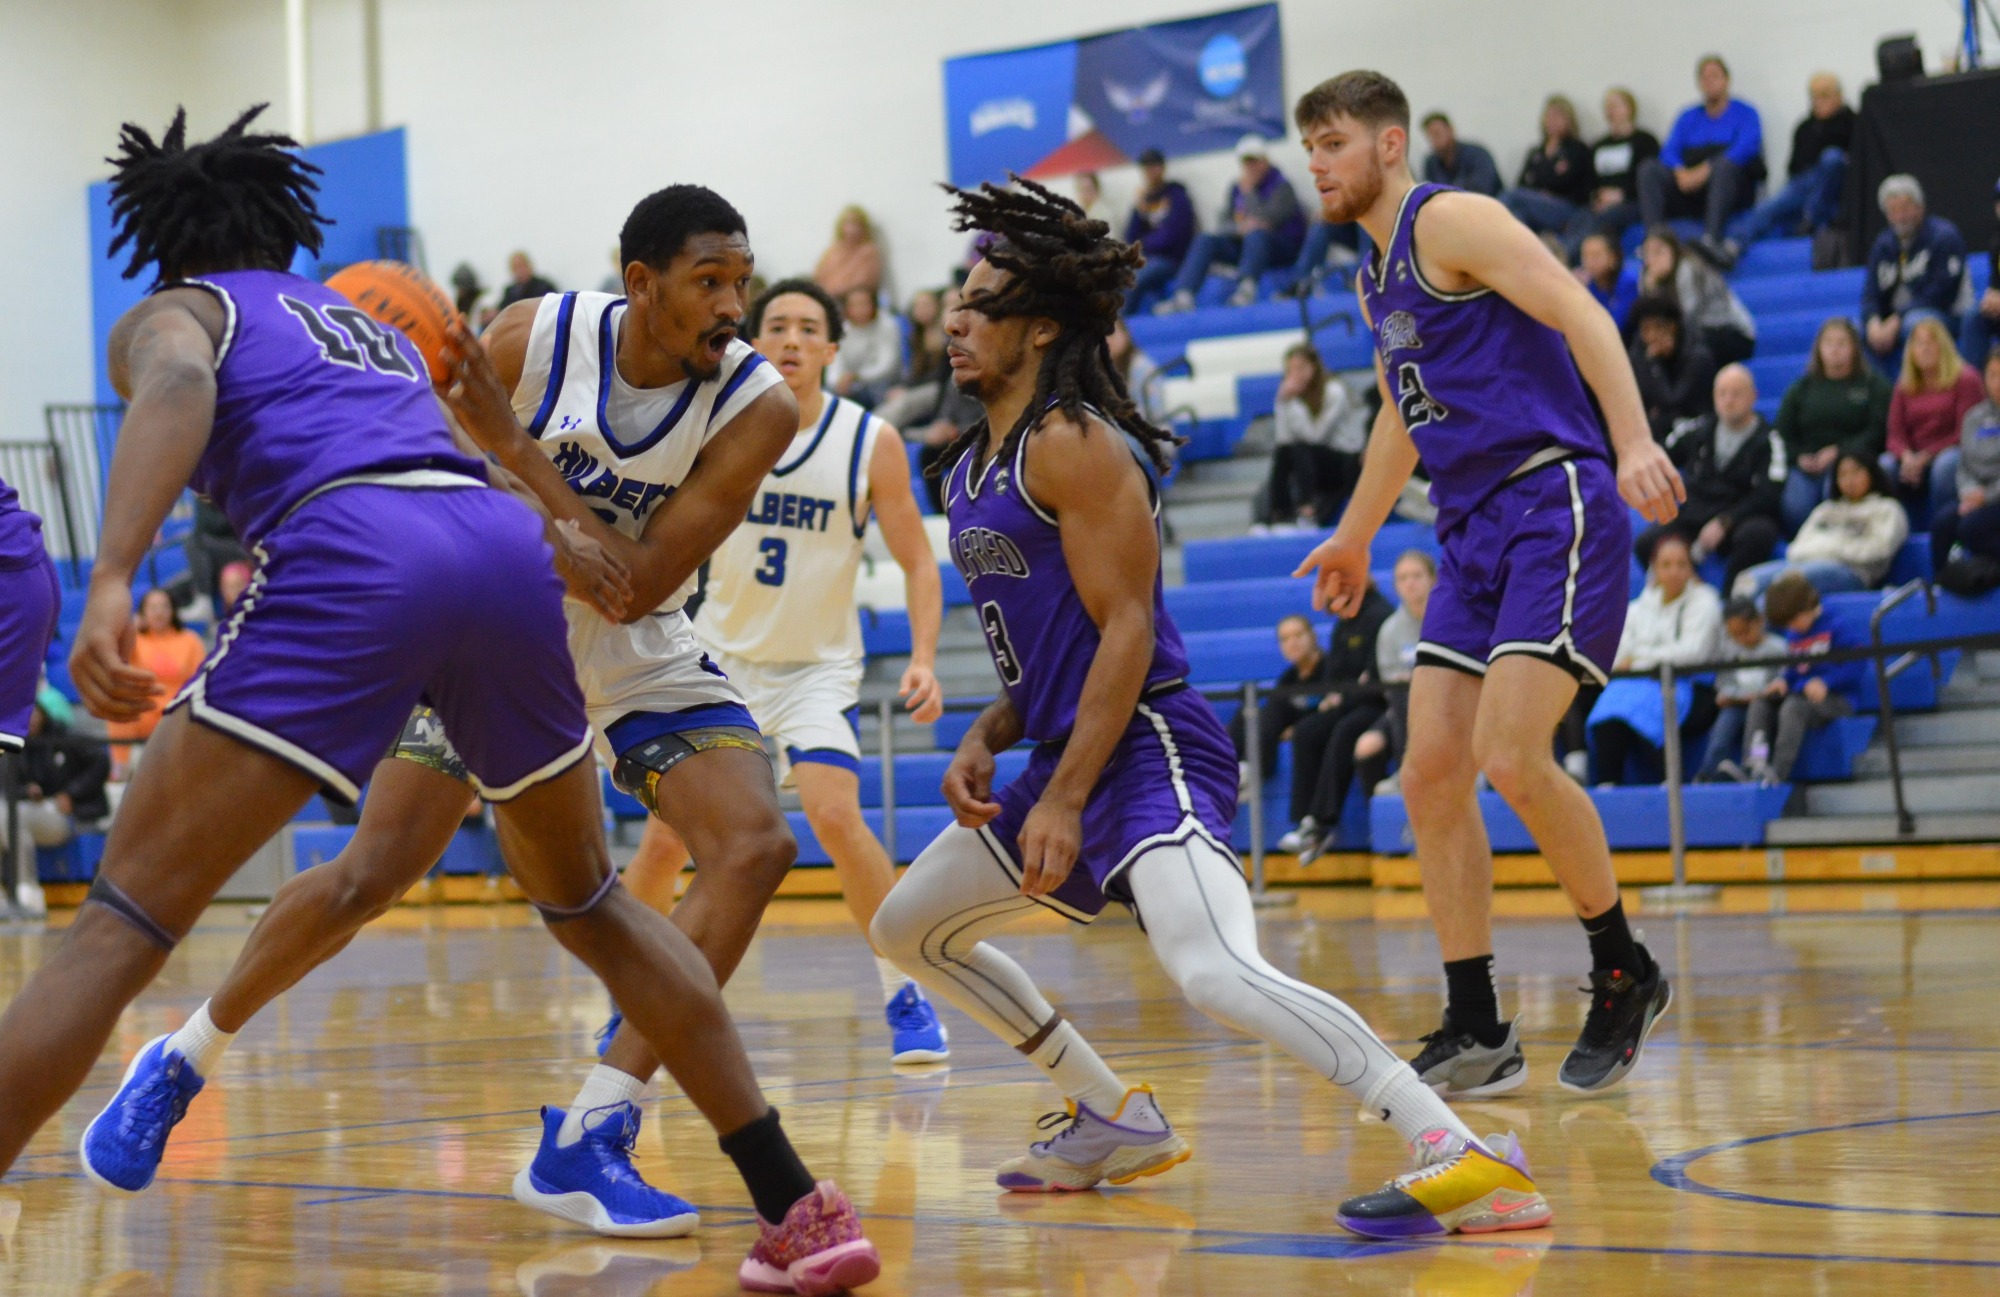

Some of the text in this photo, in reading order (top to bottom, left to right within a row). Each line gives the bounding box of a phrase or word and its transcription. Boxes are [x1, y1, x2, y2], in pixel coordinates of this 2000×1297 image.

[277, 292, 419, 383] 10
[552, 441, 678, 520] HILBER
[746, 491, 836, 532] LBERT
[754, 535, 788, 588] 3
[981, 599, 1023, 687] 3
